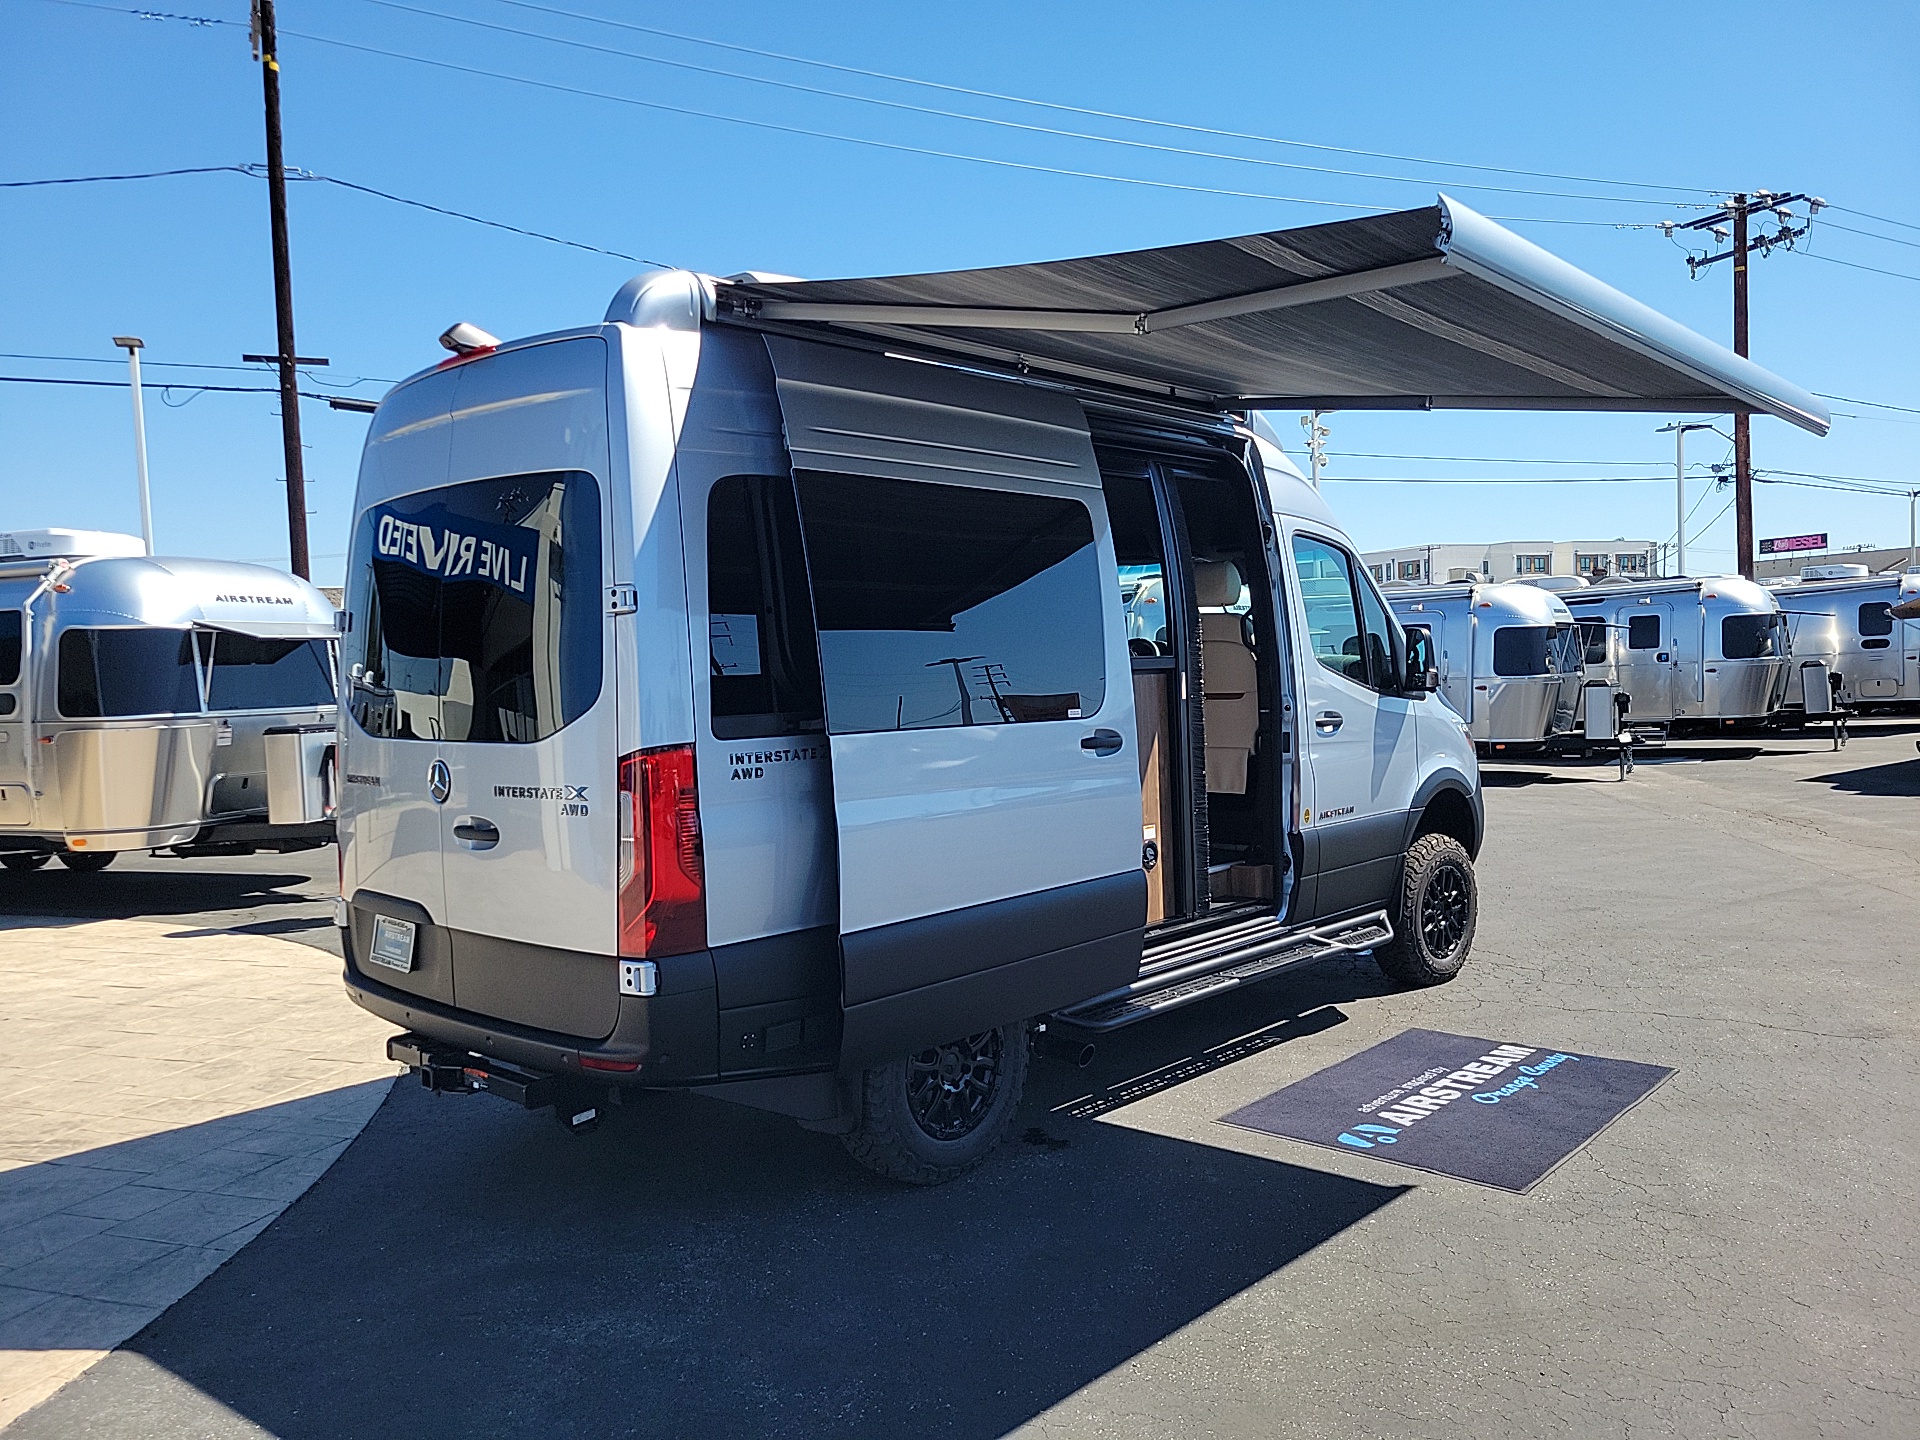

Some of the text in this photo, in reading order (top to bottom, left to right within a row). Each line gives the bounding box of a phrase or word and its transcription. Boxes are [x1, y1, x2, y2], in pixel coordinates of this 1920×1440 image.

[215, 594, 293, 605] AIRSTREAM
[728, 747, 818, 766] INTERSTATE
[730, 766, 764, 781] AWD
[560, 803, 589, 817] AWD
[1377, 1044, 1538, 1127] AIRSTREAM
[1471, 1051, 1581, 1105] Orange County
